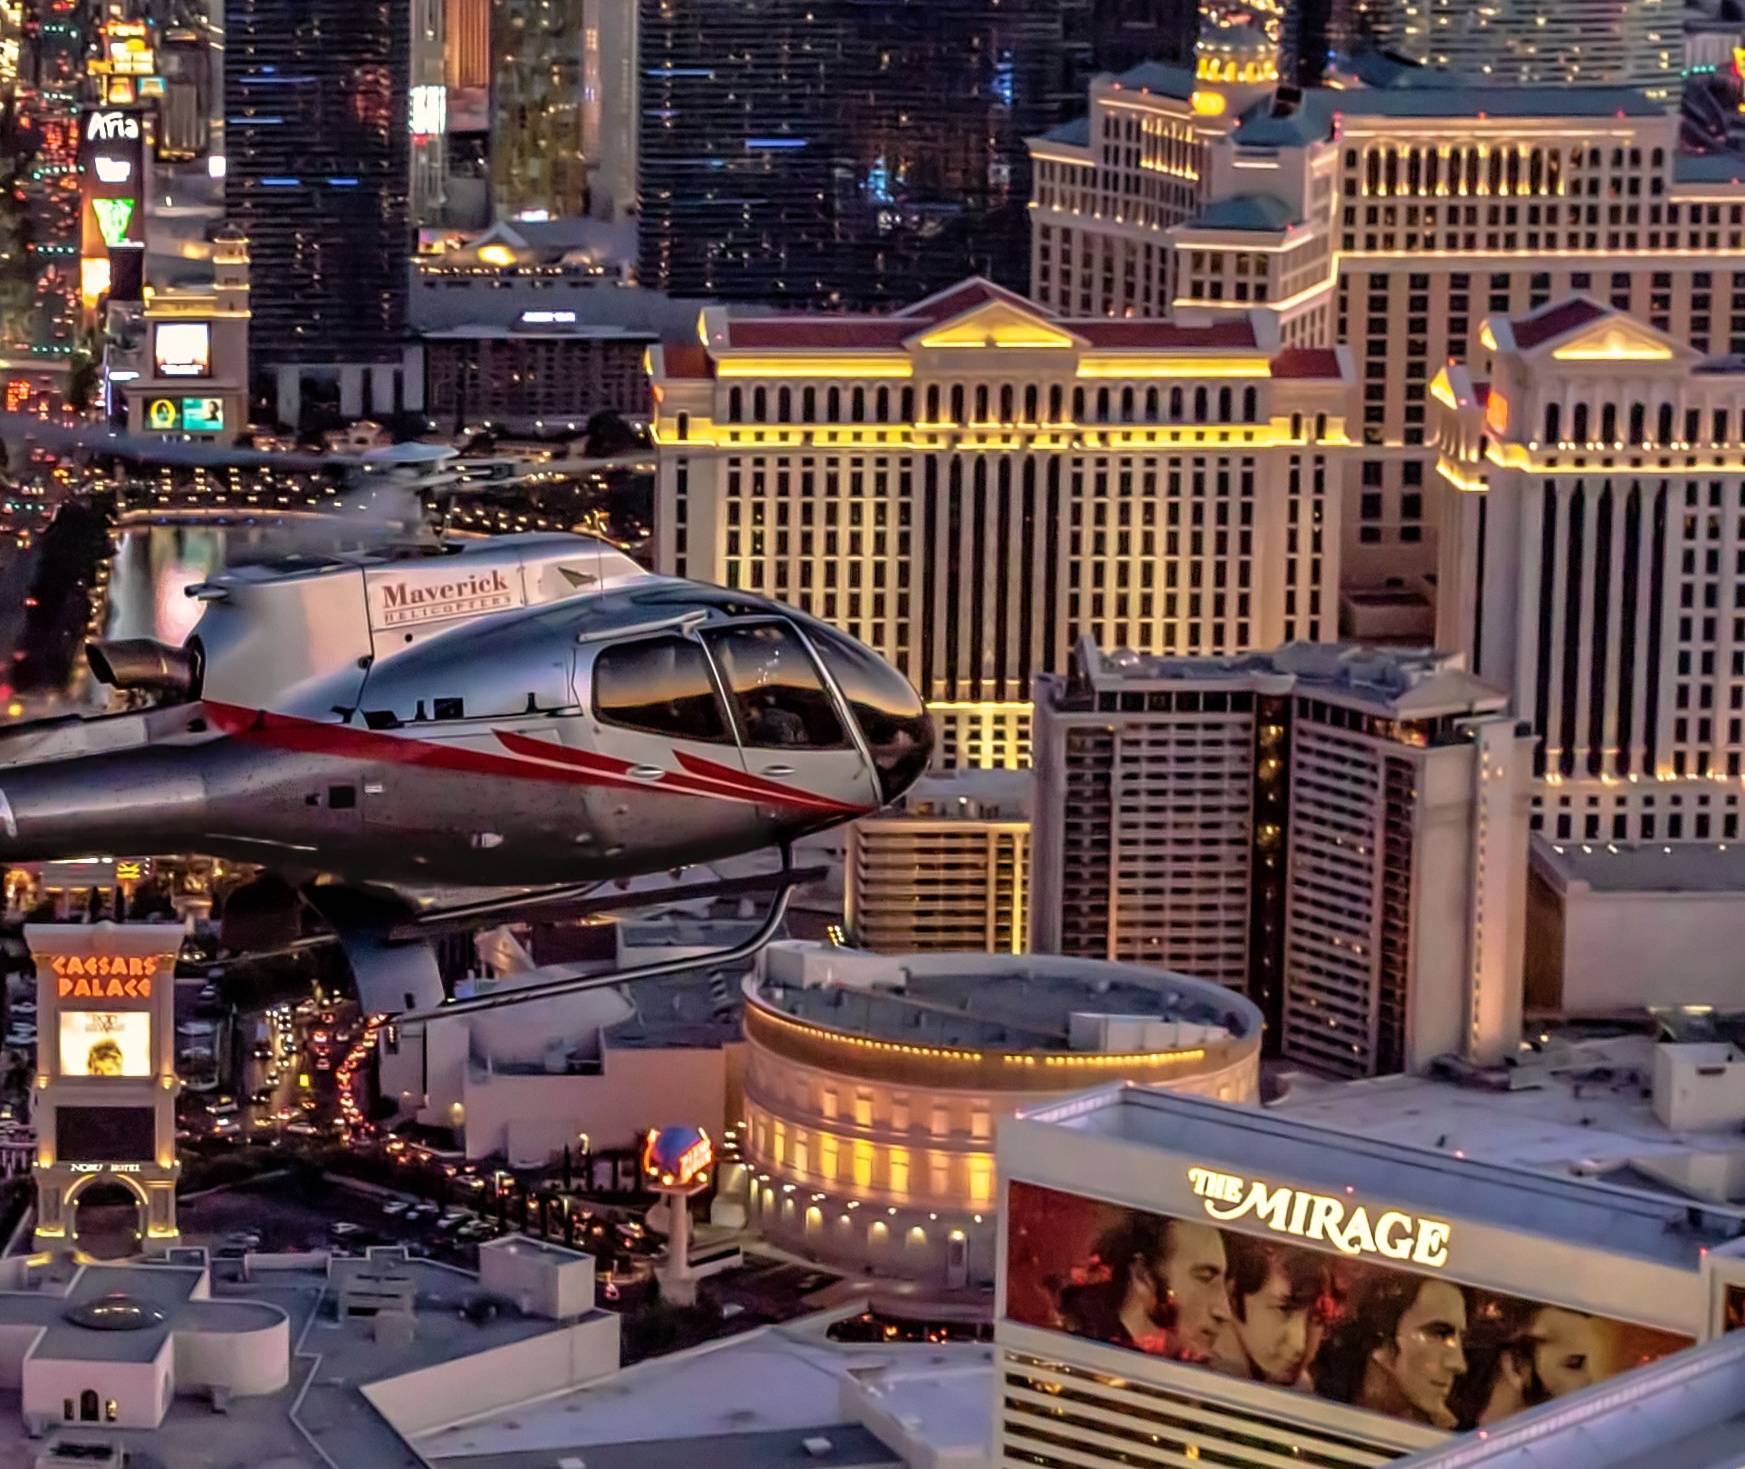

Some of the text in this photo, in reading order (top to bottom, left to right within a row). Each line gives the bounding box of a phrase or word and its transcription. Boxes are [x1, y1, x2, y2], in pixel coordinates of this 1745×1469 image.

[87, 111, 139, 141] Aria
[382, 569, 509, 609] Maverick
[51, 956, 158, 976] CAESARS
[59, 978, 151, 998] PALACE
[1188, 1167, 1451, 1268] THE MIRAGE
